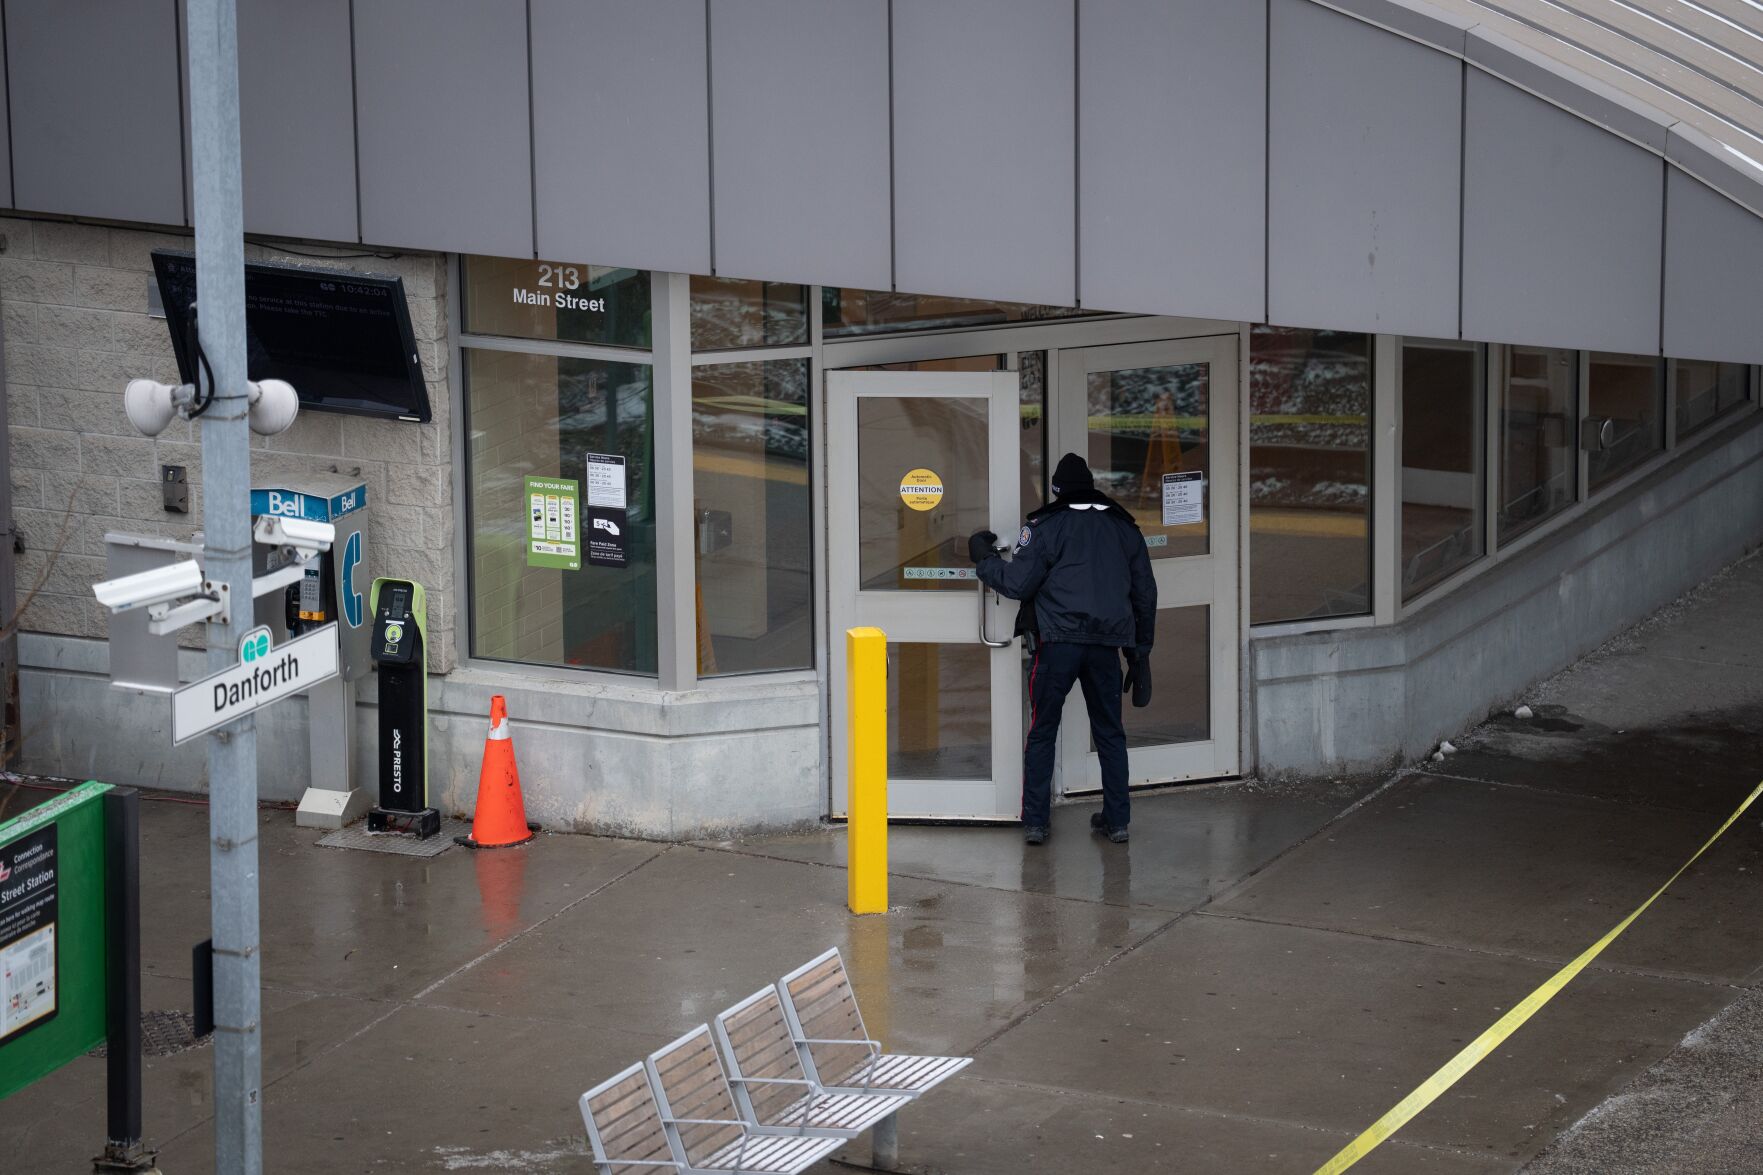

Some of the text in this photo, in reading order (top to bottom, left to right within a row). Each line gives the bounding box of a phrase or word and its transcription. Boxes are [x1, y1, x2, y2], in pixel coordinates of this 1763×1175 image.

[538, 264, 580, 290] 213
[513, 288, 605, 312] Main Street
[268, 491, 305, 517] Bell
[341, 492, 356, 512] Bell
[214, 653, 299, 712] Danforth
[393, 750, 402, 793] PRESTO
[14, 844, 43, 864] Connection
[14, 848, 54, 875] Correspondance
[1, 868, 54, 904] Street Station
